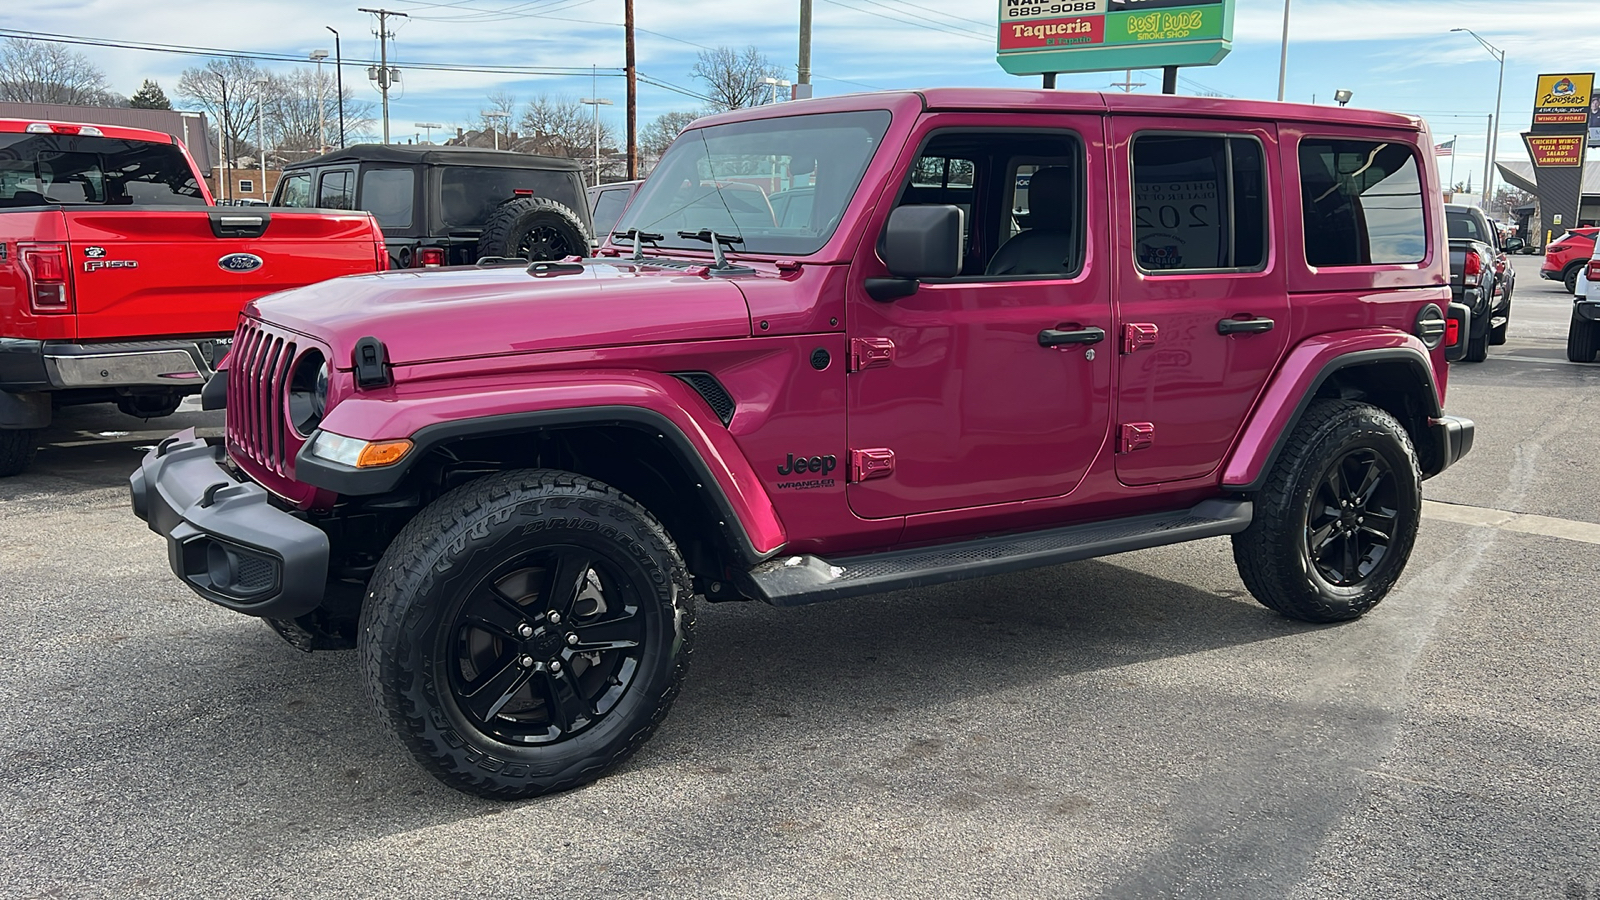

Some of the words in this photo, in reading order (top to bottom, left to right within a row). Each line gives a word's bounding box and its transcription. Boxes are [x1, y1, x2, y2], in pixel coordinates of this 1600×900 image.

[1009, 1, 1096, 17] 689-9088
[1163, 10, 1203, 32] BUDZ
[1046, 37, 1056, 45] El
[1137, 32, 1165, 40] SMOKE
[1167, 30, 1190, 39] SHOP
[1542, 94, 1585, 106] Roosters
[229, 257, 254, 268] Ford
[777, 452, 837, 476] Jeep
[777, 478, 835, 489] WRANGLER
[429, 706, 560, 778] DUELER
